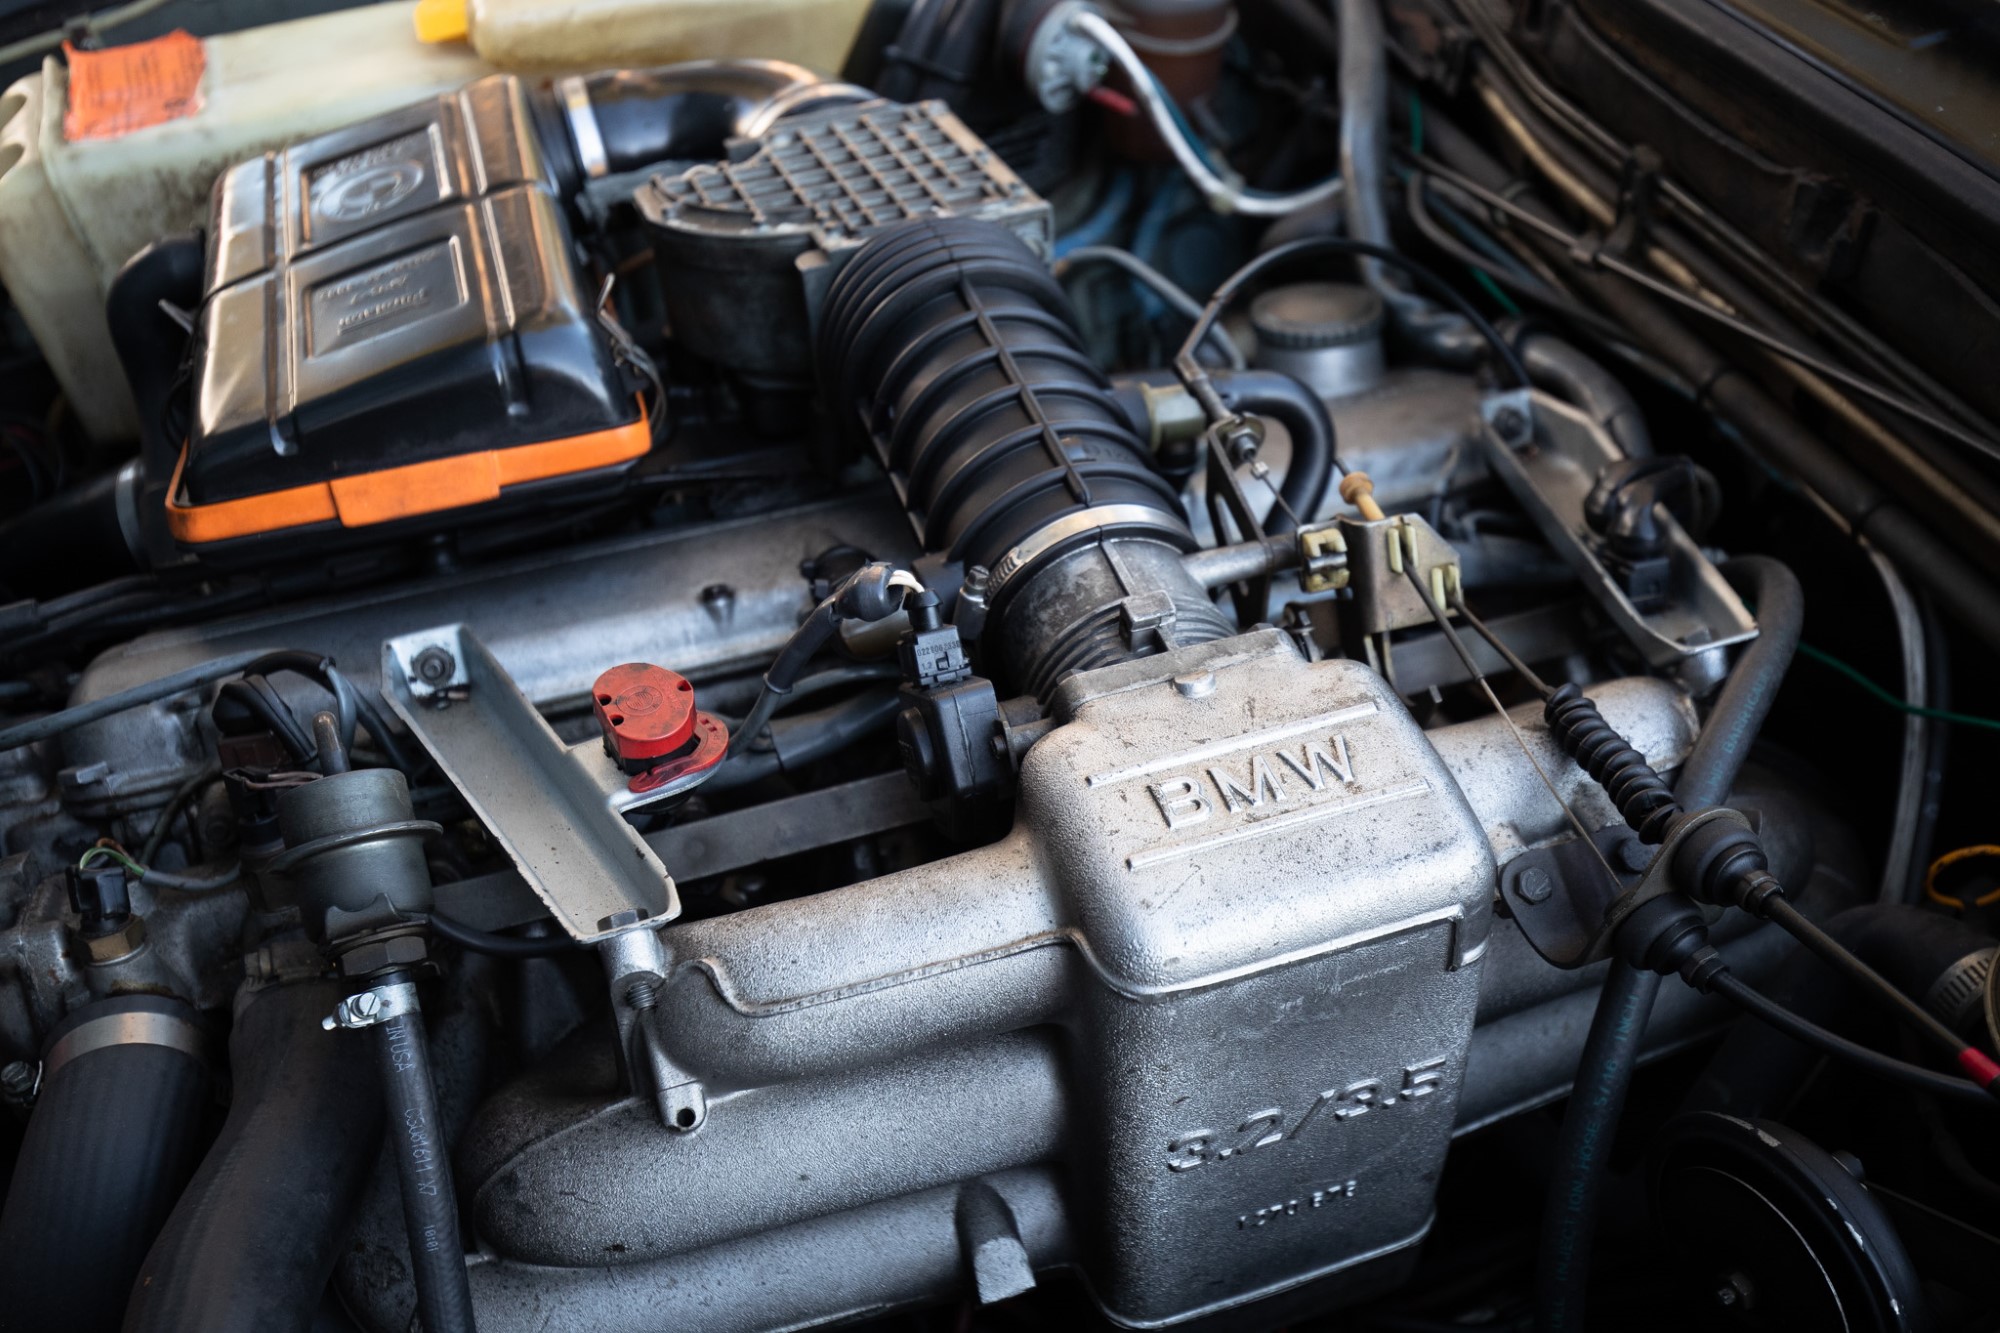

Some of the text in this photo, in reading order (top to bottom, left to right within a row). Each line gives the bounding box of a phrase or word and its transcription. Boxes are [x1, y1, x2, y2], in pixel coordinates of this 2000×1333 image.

[1145, 734, 1355, 831] BMW
[385, 1023, 406, 1041] IN
[390, 1042, 416, 1073] USA
[1167, 1054, 1447, 1174] 3.2/3.5
[1578, 1120, 1601, 1170] HOSE
[1592, 1057, 1618, 1107] 5/16
